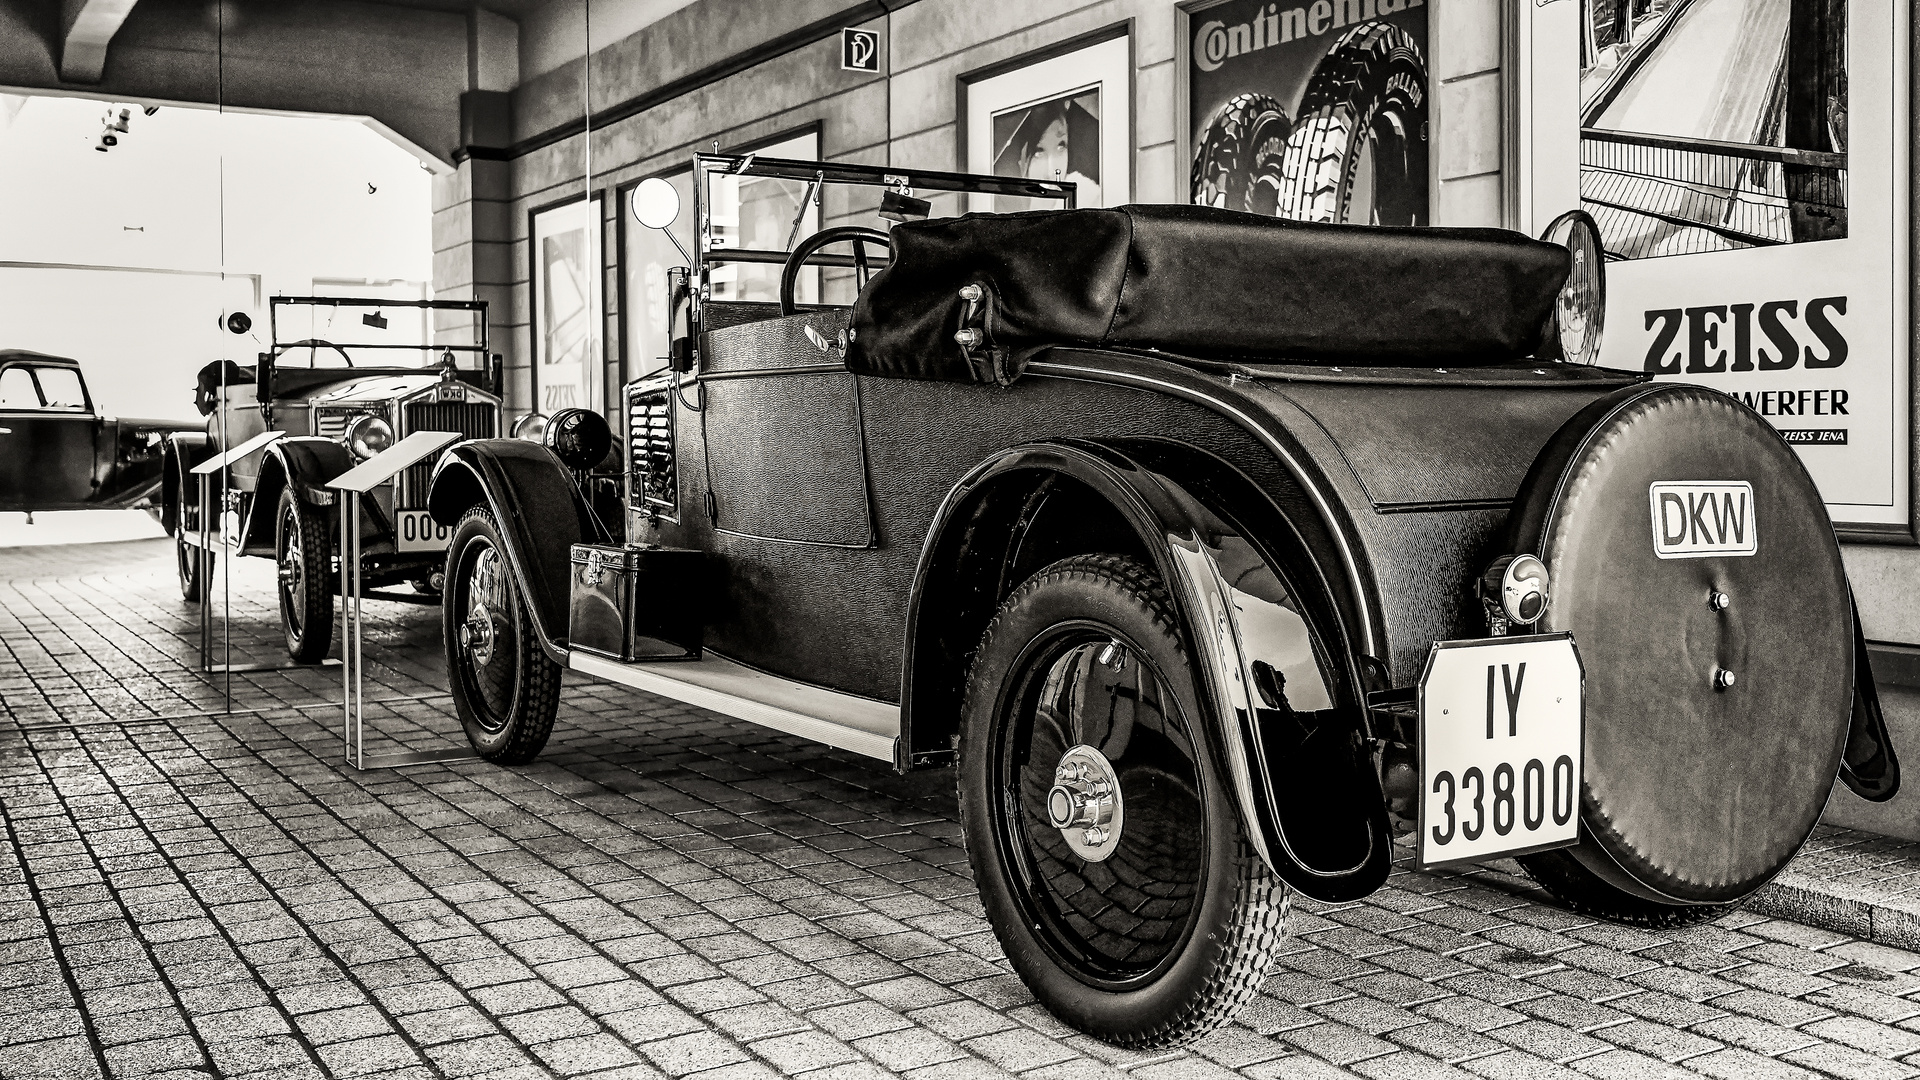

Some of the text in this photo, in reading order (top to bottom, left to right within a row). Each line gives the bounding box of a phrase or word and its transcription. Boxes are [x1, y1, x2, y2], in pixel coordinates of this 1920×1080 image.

[1193, 0, 1424, 71] Continen
[1385, 72, 1422, 108] BALLON
[1643, 296, 1848, 375] ZEISS
[1728, 389, 1849, 415] WERFER
[1783, 431, 1845, 441] ZEISS JENA
[1659, 491, 1746, 546] DKW
[1486, 662, 1526, 739] IY
[1432, 754, 1574, 846] 33800
